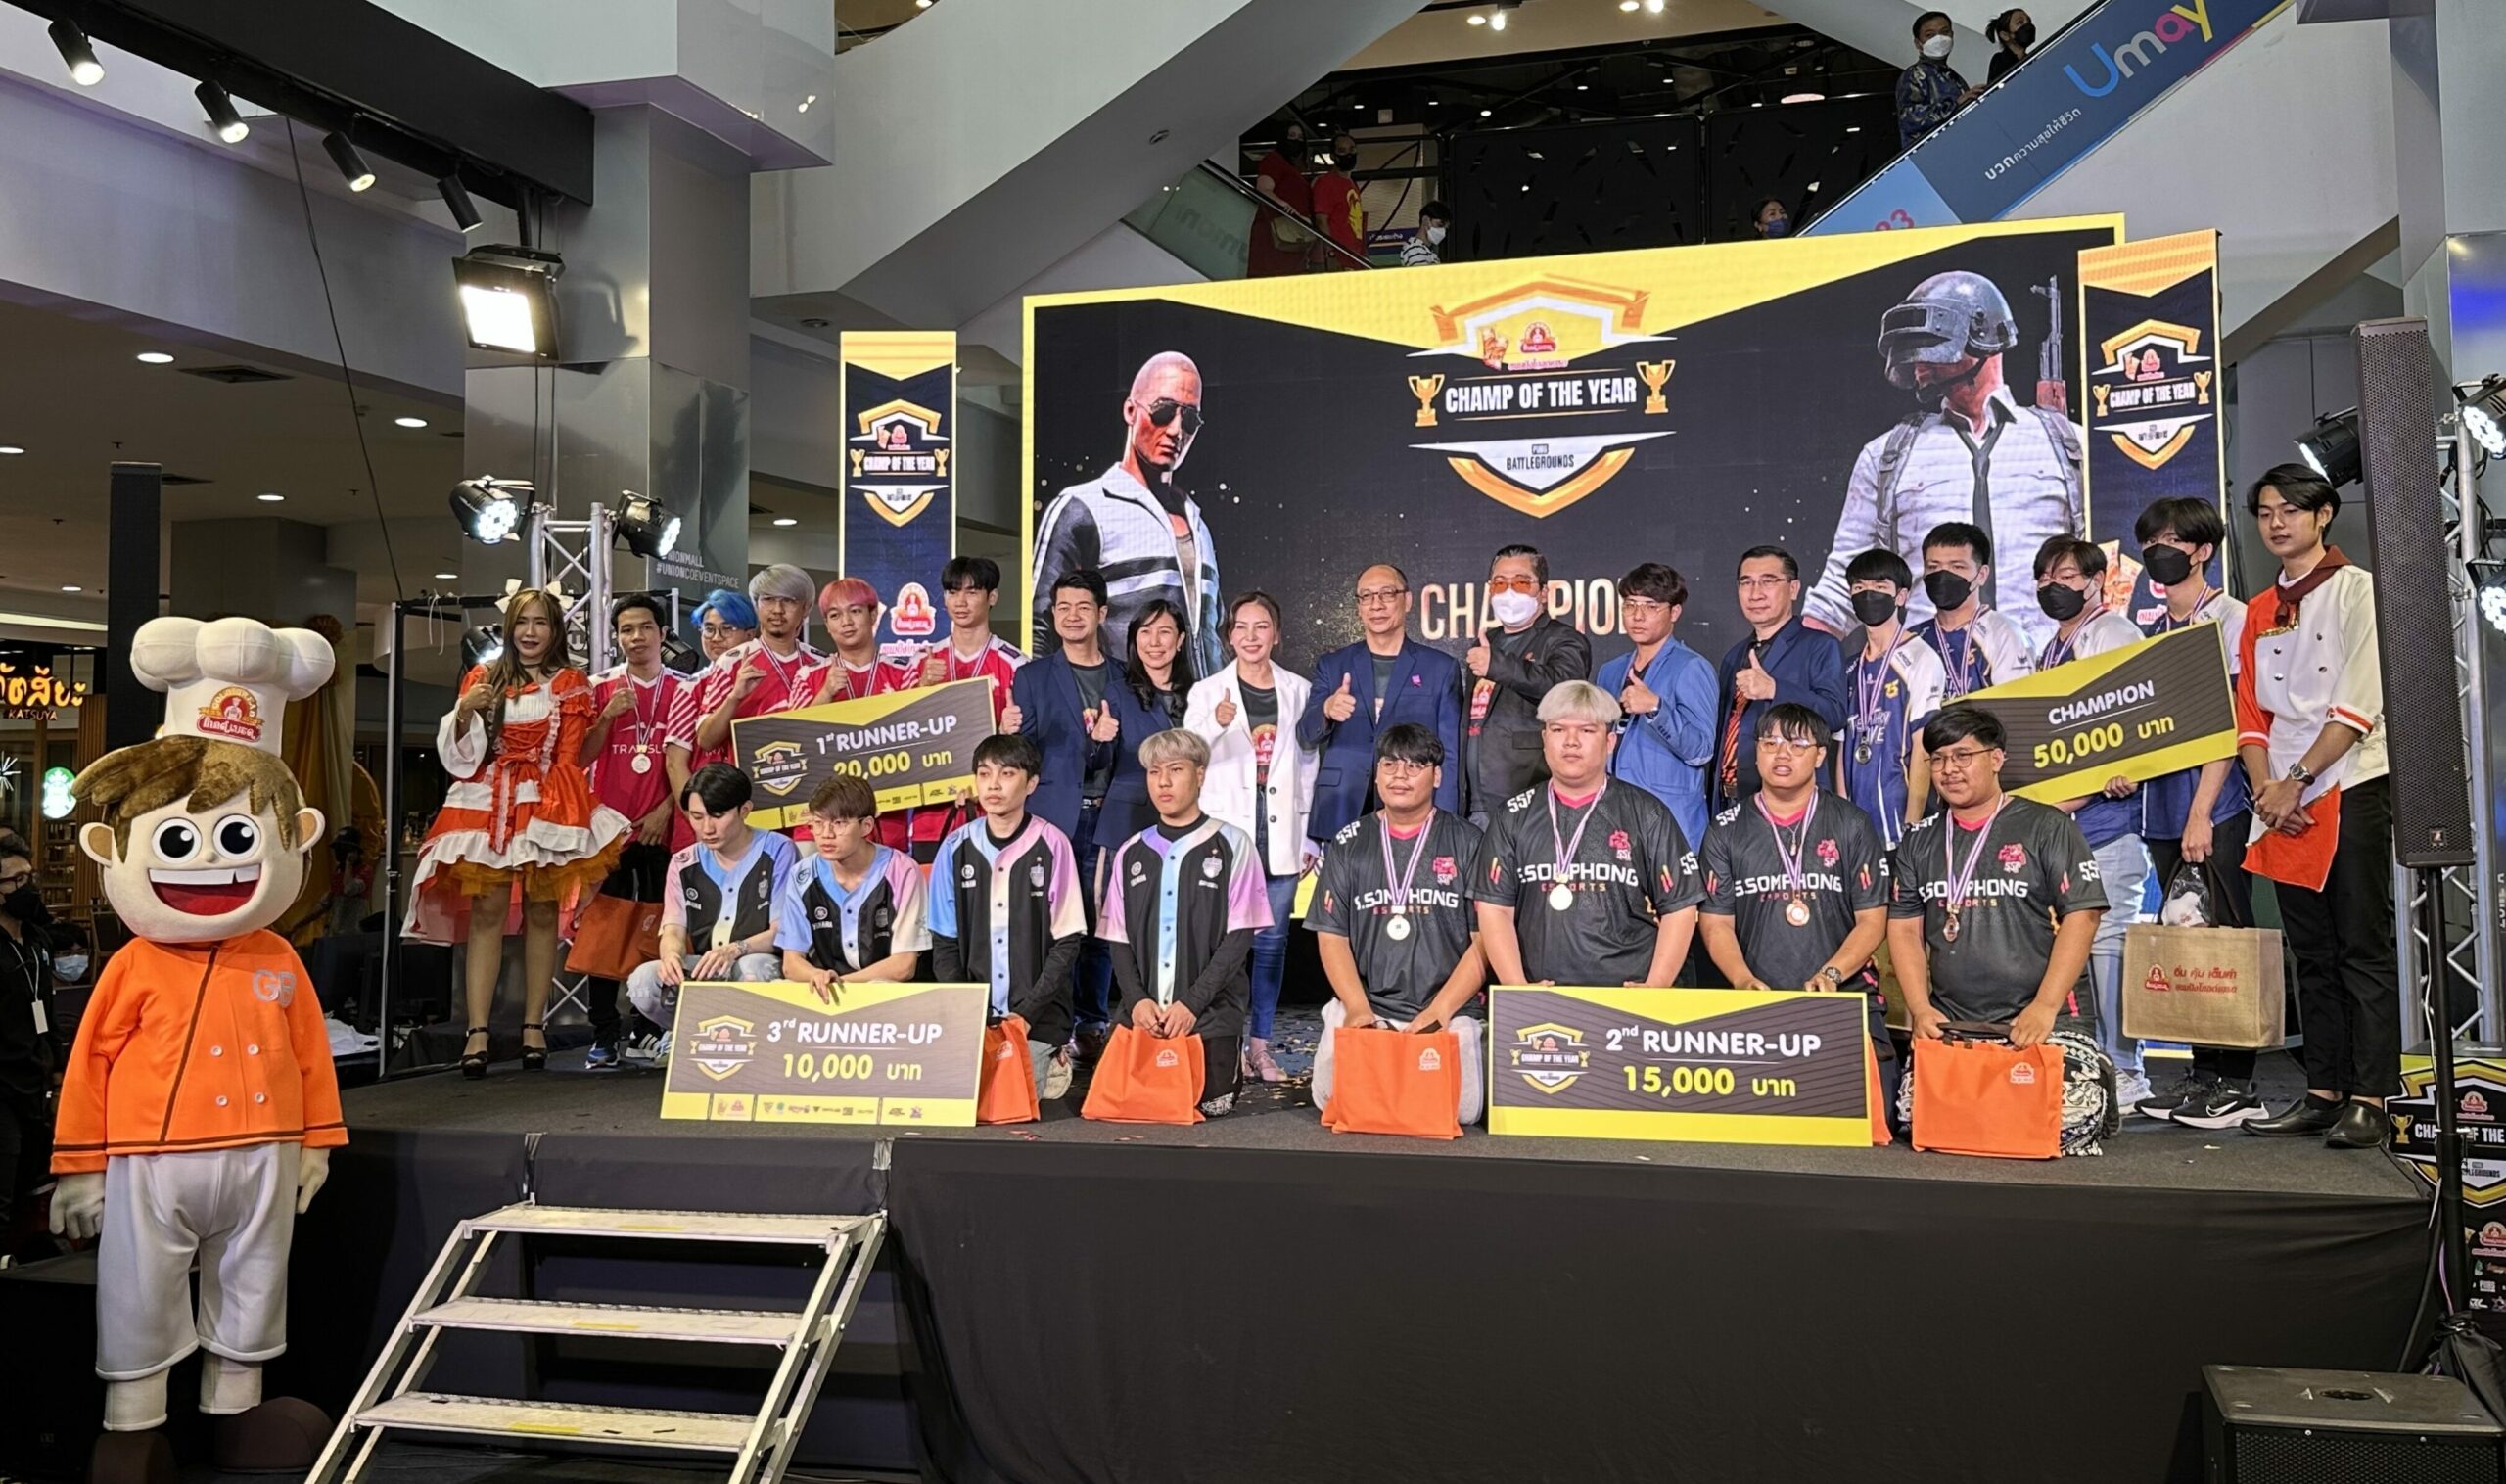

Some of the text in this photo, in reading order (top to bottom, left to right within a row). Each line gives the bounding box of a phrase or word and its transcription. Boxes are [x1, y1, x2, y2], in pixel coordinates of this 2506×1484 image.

[2063, 0, 2213, 97] Umay
[1445, 377, 1637, 413] CHAMP OF THE YEAR
[1506, 454, 1574, 470] BATTLEGROUNDS
[8, 708, 58, 721] KATSUYA
[2048, 680, 2155, 725] CHAMPION
[836, 715, 957, 753] RUNNER-UP
[2033, 716, 2175, 769] 50,000 บาท
[921, 750, 952, 768] บาท
[1335, 820, 1361, 845] SSP
[1680, 851, 1699, 875] SS
[766, 1017, 943, 1045] 3rd RUNNER-UP
[1605, 1025, 1822, 1057] 2nd RUNNER-UP
[783, 1052, 922, 1083] 10,000 บาท
[1623, 1065, 1797, 1099] 15,000 บาท
[2482, 1127, 2505, 1143] THE
